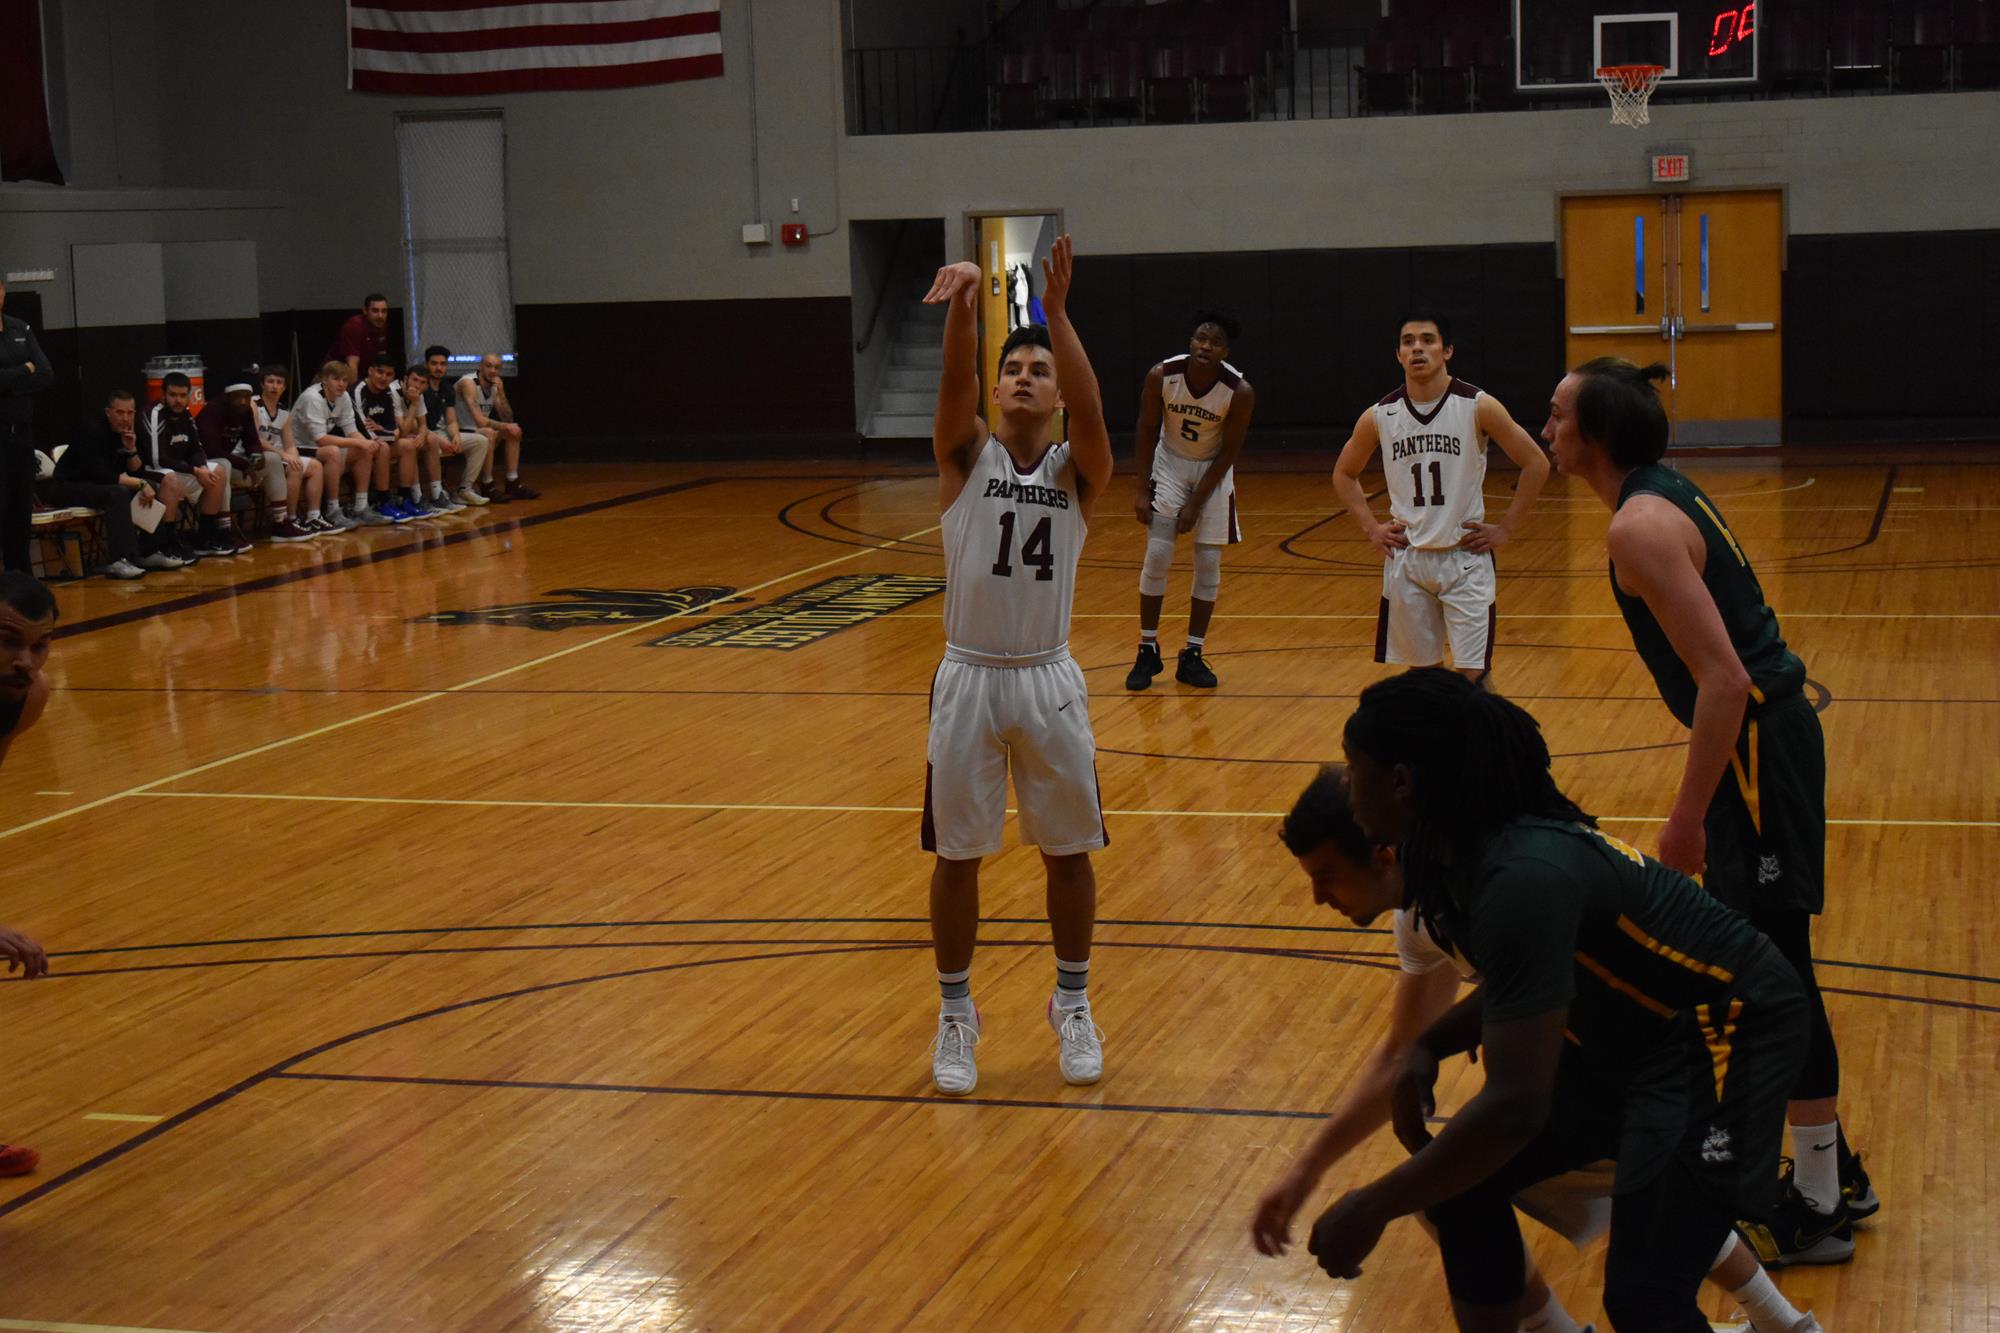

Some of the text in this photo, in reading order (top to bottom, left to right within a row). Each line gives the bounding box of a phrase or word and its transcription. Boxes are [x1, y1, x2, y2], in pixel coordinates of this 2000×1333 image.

[1657, 158, 1683, 177] EXIT
[1167, 403, 1222, 422] PANTHERS
[1181, 419, 1202, 441] 5
[1392, 433, 1461, 461] PANTHERS
[1411, 461, 1445, 506] 11
[992, 511, 1053, 581] 14
